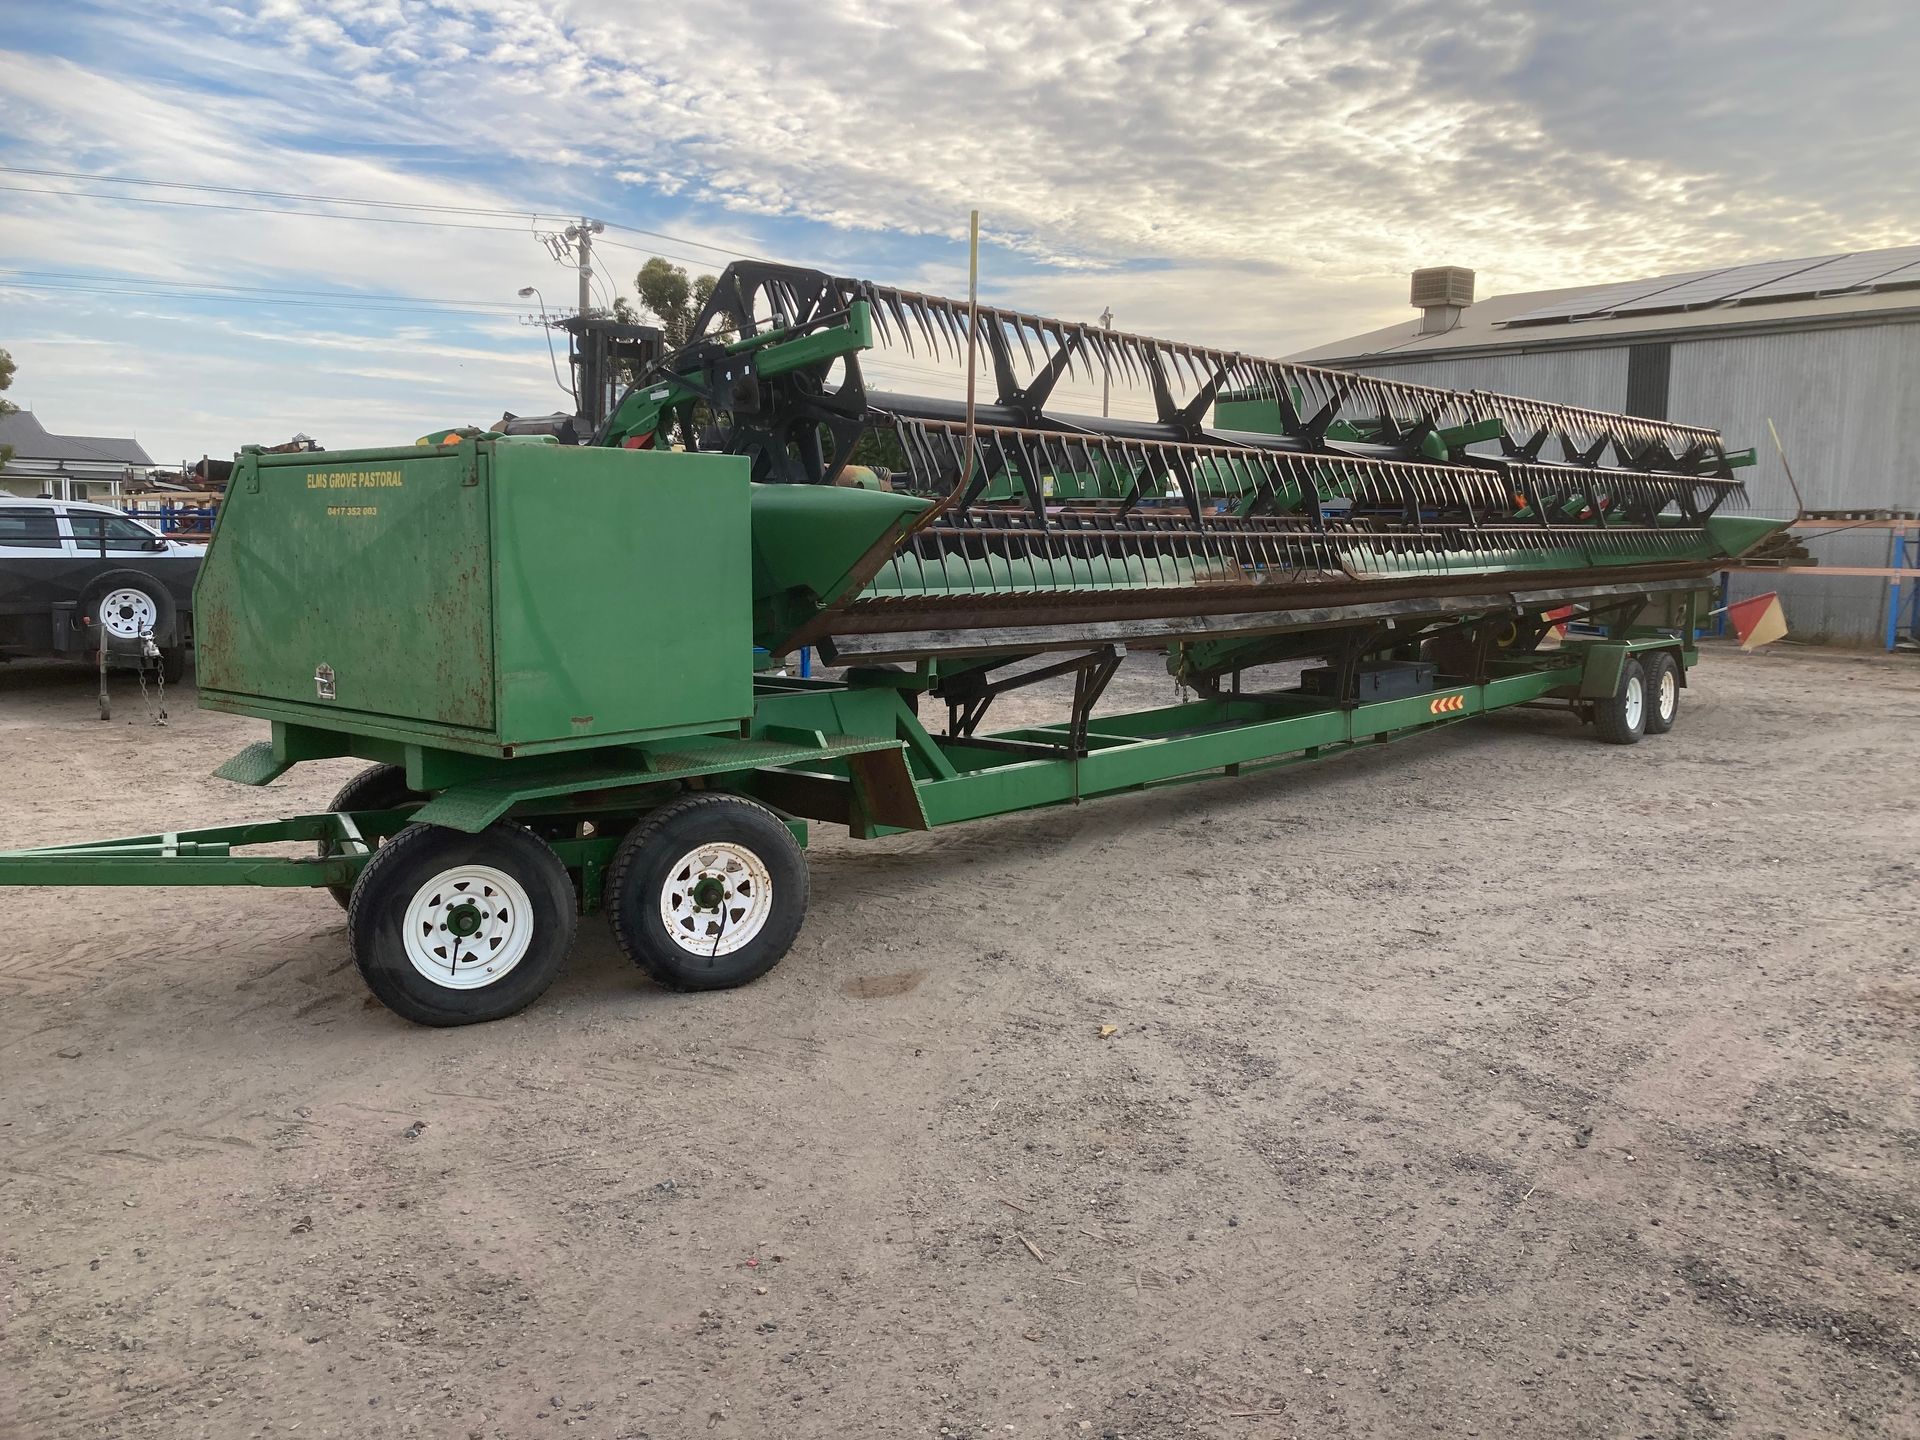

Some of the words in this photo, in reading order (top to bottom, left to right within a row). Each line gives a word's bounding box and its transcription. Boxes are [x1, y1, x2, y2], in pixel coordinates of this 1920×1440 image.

[307, 473, 327, 489] ELMS
[329, 472, 357, 488] GROVE
[358, 471, 402, 487] PASTORAL
